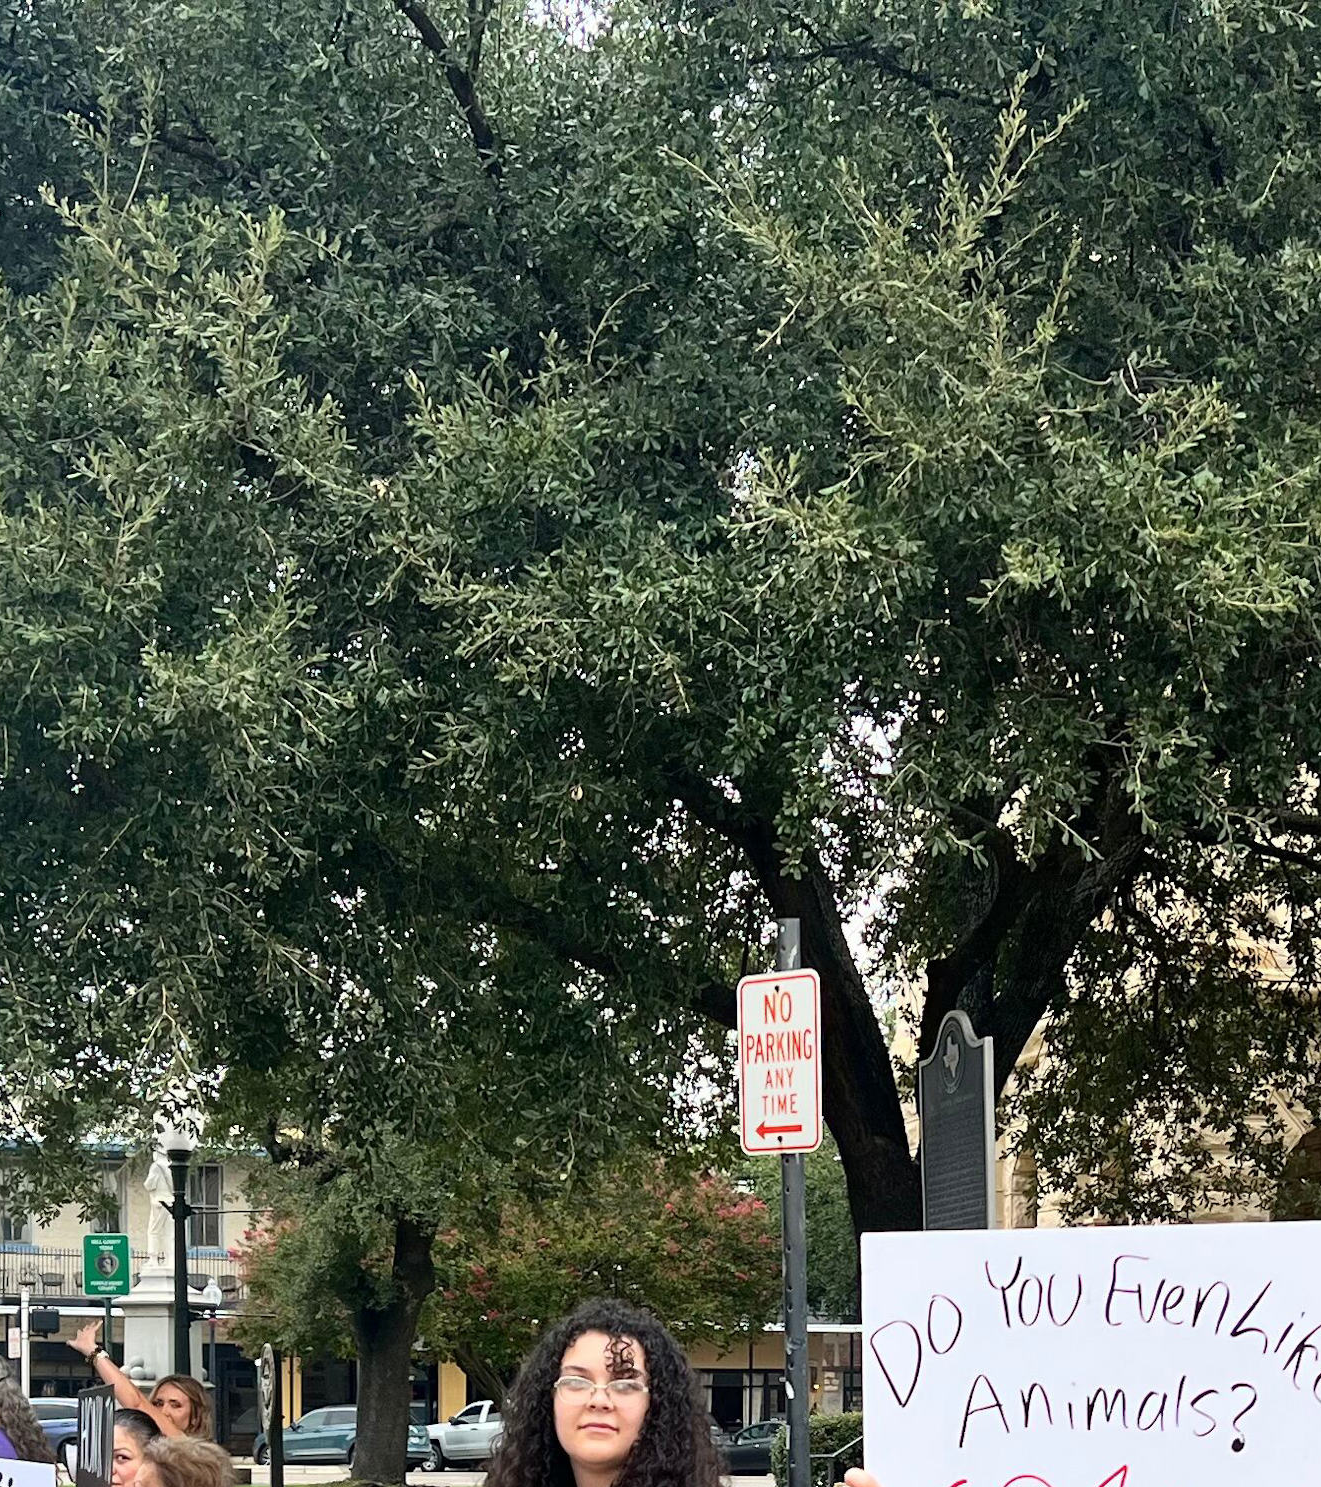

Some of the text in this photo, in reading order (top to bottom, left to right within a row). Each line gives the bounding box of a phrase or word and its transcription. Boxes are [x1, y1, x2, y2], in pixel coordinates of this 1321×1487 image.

[764, 991, 793, 1024] NO
[746, 1029, 812, 1064] PARKING
[765, 1067, 794, 1090] ANY
[762, 1093, 799, 1116] TIME
[985, 1256, 1083, 1329] YOU
[1106, 1254, 1232, 1336] Even
[959, 1373, 1258, 1453] Animals?
